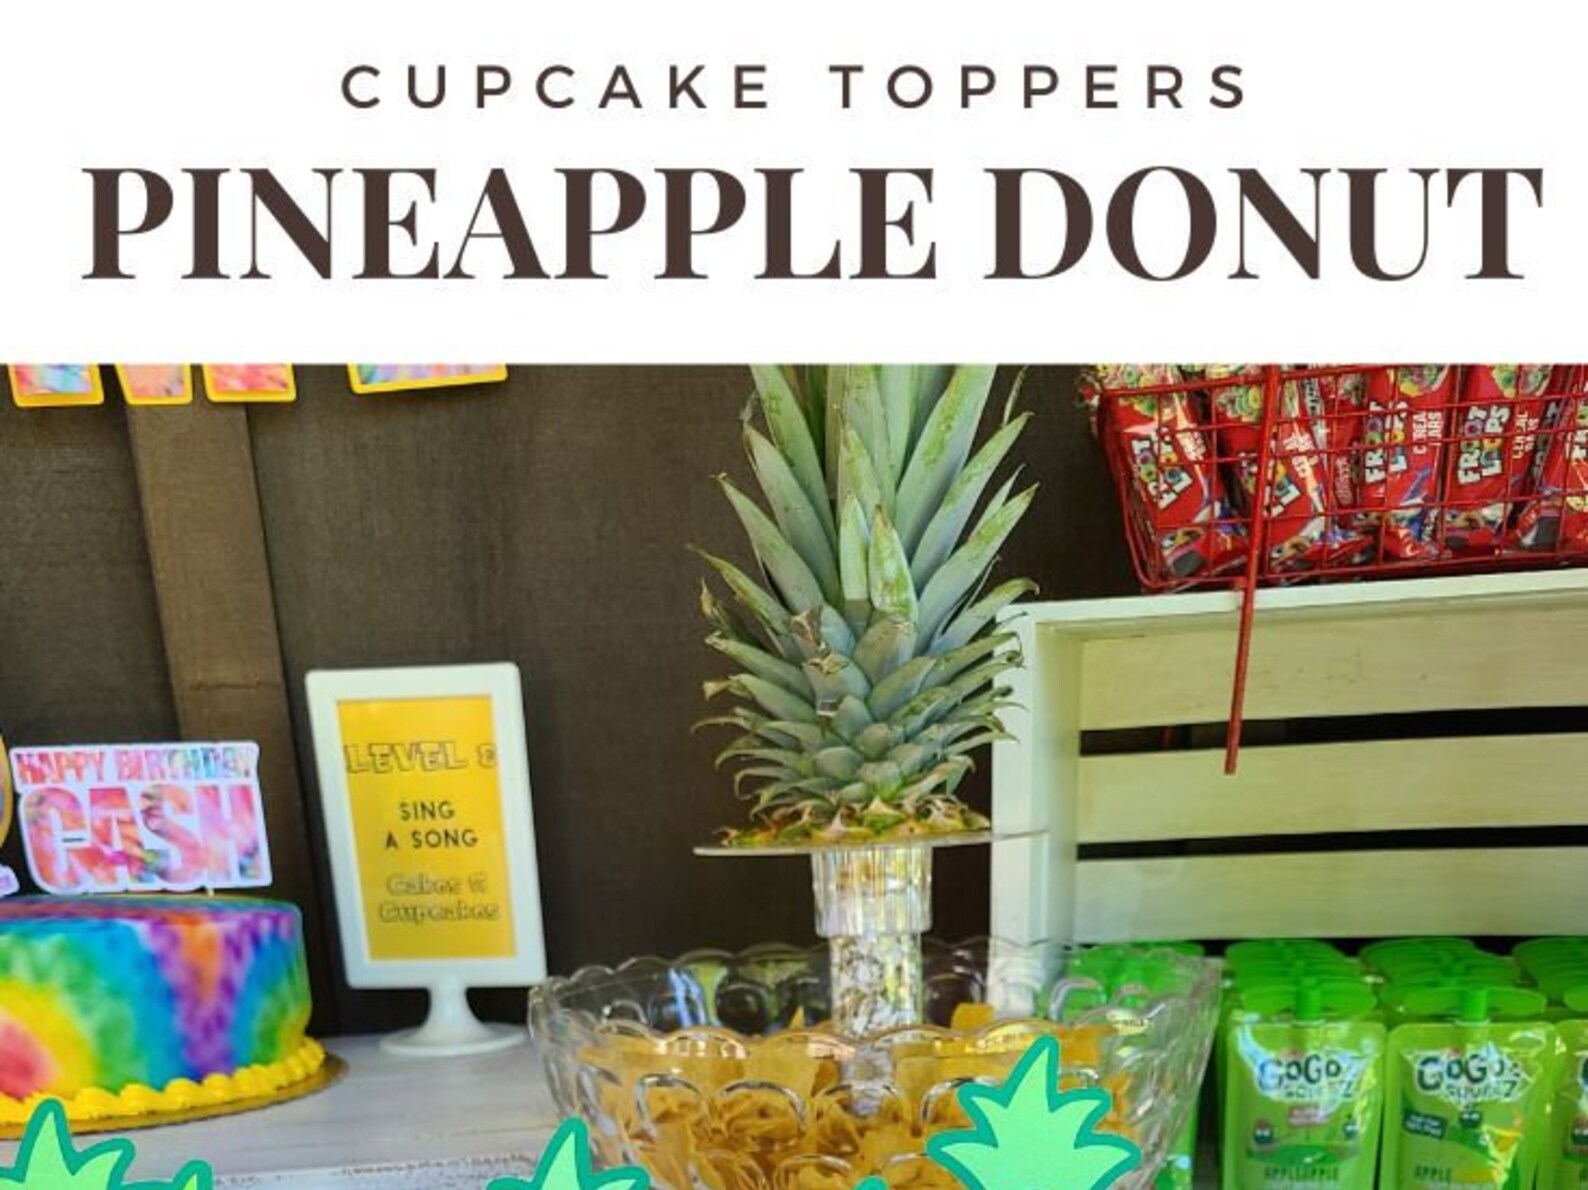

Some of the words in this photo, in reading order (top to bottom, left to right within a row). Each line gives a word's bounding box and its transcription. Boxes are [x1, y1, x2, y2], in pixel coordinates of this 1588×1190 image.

[1458, 406, 1488, 484] FROOT
[15, 750, 106, 785] HAPPY
[113, 747, 252, 782] BIRTHDAY
[342, 740, 469, 774] LEVEL
[398, 800, 456, 821] SING
[23, 783, 264, 887] CASH
[385, 831, 399, 850] A
[410, 829, 480, 850] SONG
[378, 899, 502, 925] Cupcakes
